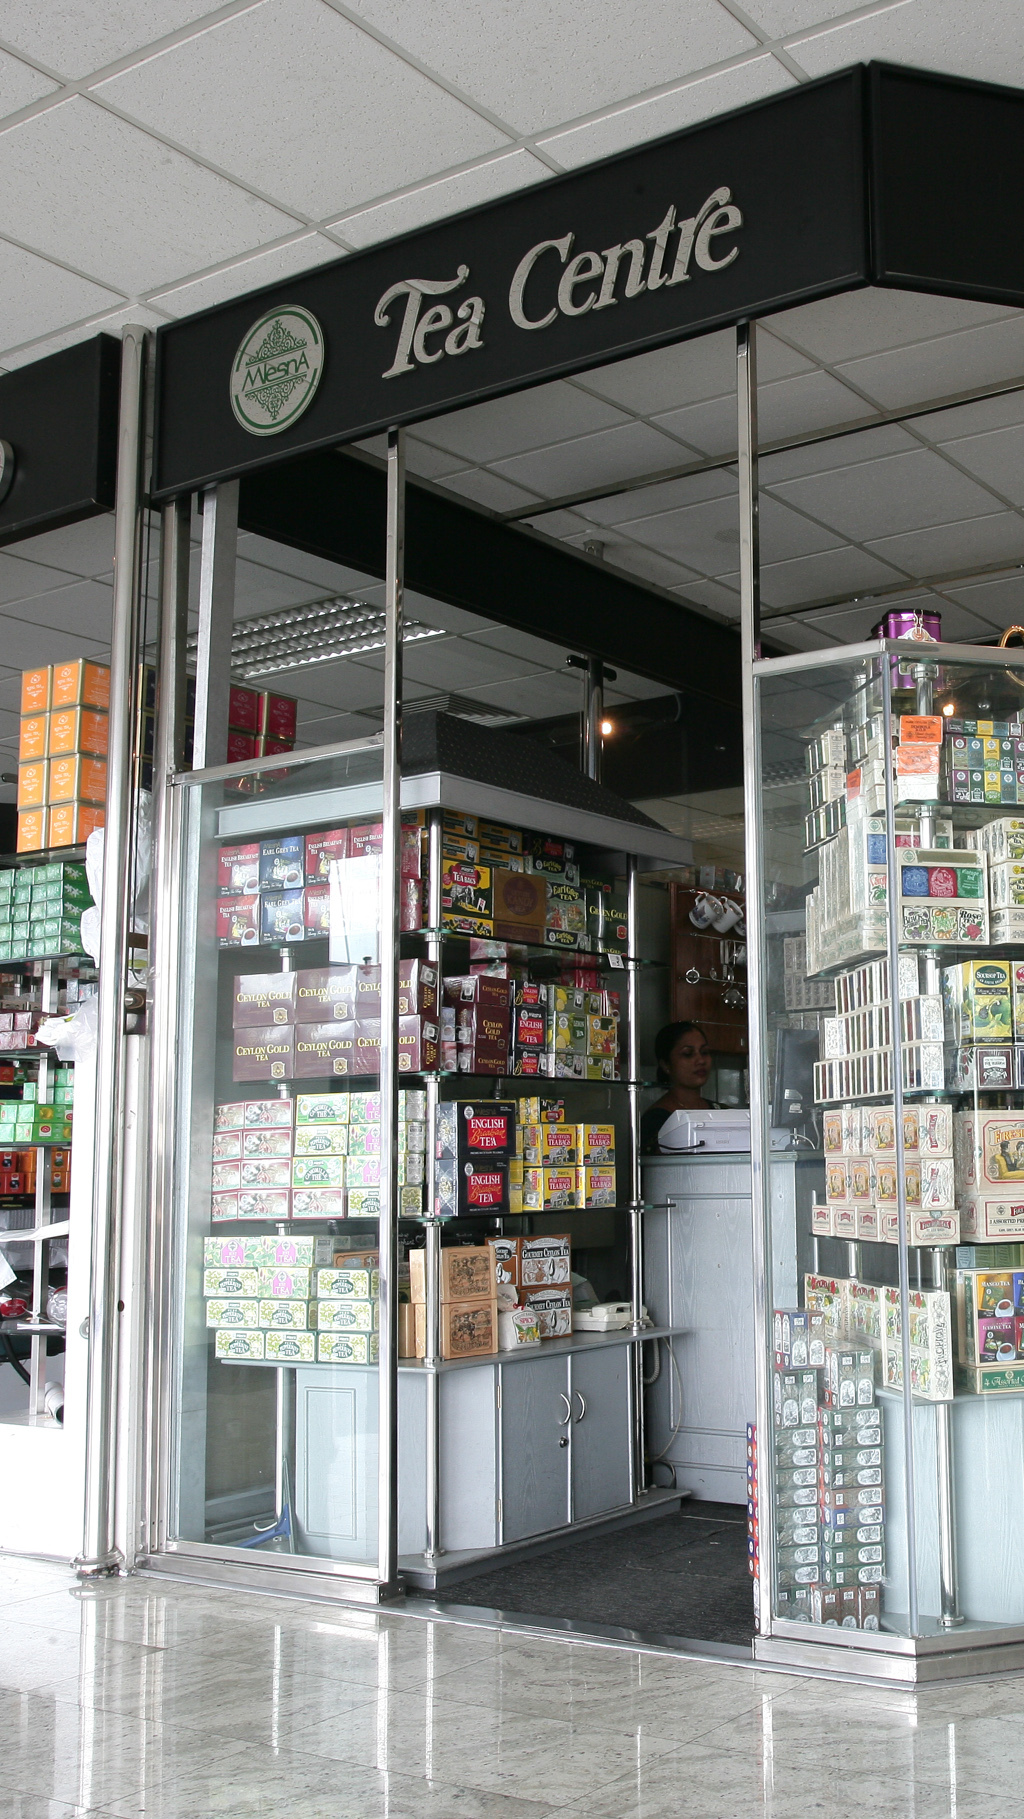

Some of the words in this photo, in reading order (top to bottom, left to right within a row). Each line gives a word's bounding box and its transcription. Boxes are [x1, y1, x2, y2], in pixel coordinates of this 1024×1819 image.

[374, 264, 486, 379] Tea
[508, 186, 743, 332] Centre
[262, 848, 275, 856] EARL
[276, 846, 289, 854] GREY
[452, 871, 464, 882] TEA
[611, 909, 628, 919] GOLD
[960, 910, 982, 920] Rose
[237, 992, 268, 1003] CEYLON
[269, 990, 292, 1000] GOLD
[299, 988, 328, 998] CEYLON
[330, 985, 353, 995] GOLD
[256, 1000, 270, 1008] TEA
[482, 1020, 503, 1028] CEYLON
[520, 1021, 542, 1029] ENGLISH
[485, 1027, 500, 1035] GOLD
[236, 1046, 266, 1056] CEYLON
[267, 1044, 289, 1053] GOLD
[297, 1042, 327, 1052] CEYLON
[329, 1040, 352, 1049] GOLD
[471, 1119, 504, 1128] ENGLISH
[480, 1137, 497, 1146] TEA
[470, 1175, 500, 1185] ENGLISH
[478, 1193, 493, 1202] TEA
[522, 1249, 543, 1259] GOURMET
[543, 1248, 560, 1256] CEYLON
[560, 1246, 569, 1255] TEA
[546, 1300, 562, 1308] CEYLON
[562, 1299, 571, 1307] TEA
[991, 1377, 1020, 1386] Assorted
